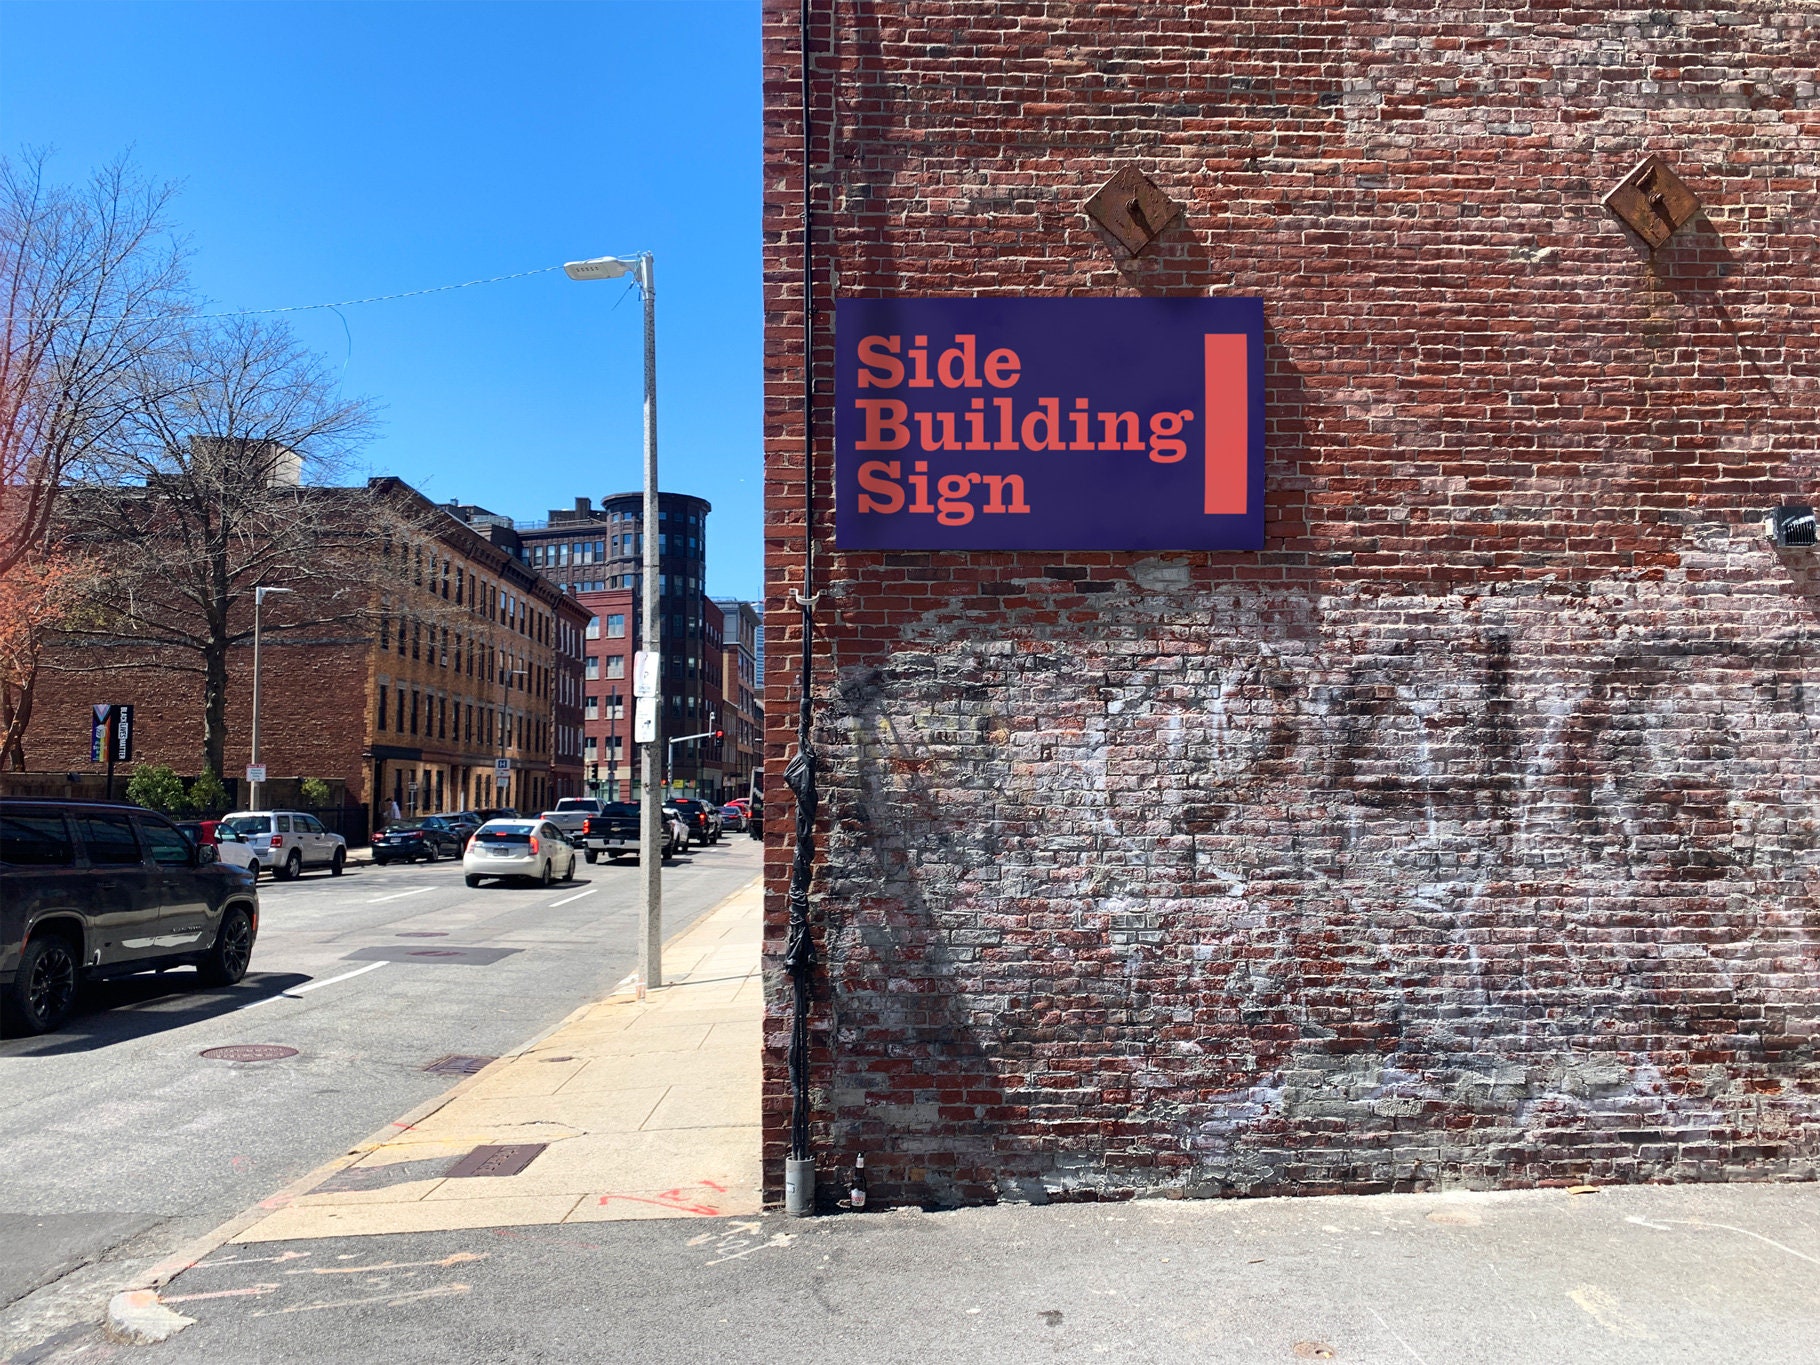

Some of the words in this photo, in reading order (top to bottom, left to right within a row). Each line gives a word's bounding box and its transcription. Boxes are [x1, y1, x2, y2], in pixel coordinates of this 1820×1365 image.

[857, 334, 1021, 389] Side
[855, 397, 1194, 464] Building
[857, 460, 1030, 527] Sign
[119, 723, 127, 738] LIVES
[120, 706, 128, 723] BLACK
[118, 739, 126, 760] MATTER
